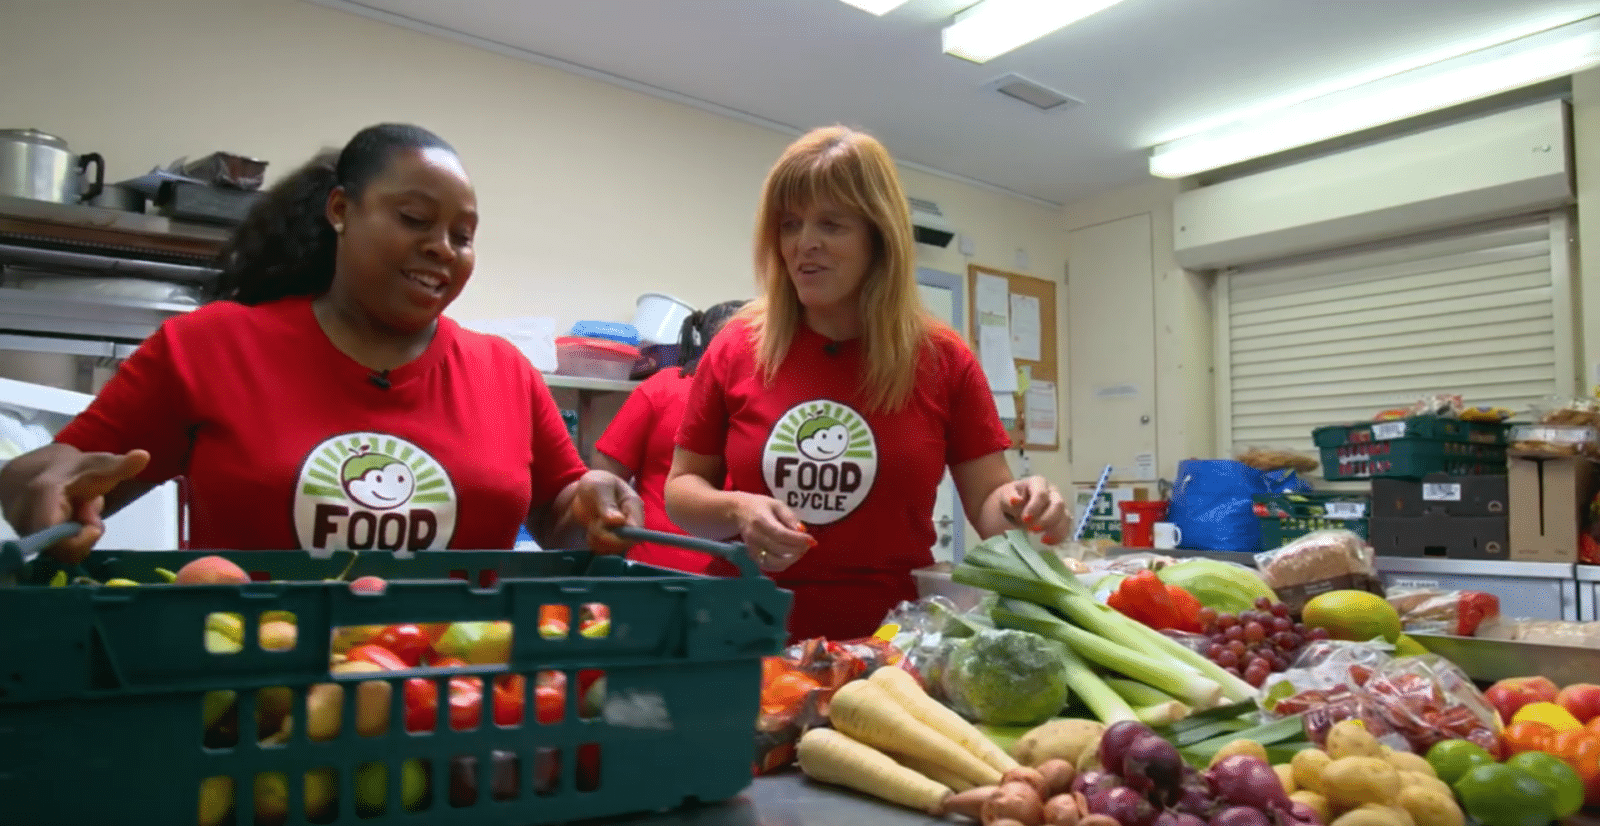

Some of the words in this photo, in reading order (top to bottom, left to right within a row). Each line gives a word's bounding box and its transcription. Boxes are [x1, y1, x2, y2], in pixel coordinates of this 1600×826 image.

[775, 456, 862, 493] FOOD
[787, 491, 847, 511] CYCLE
[312, 503, 438, 551] FOOD
